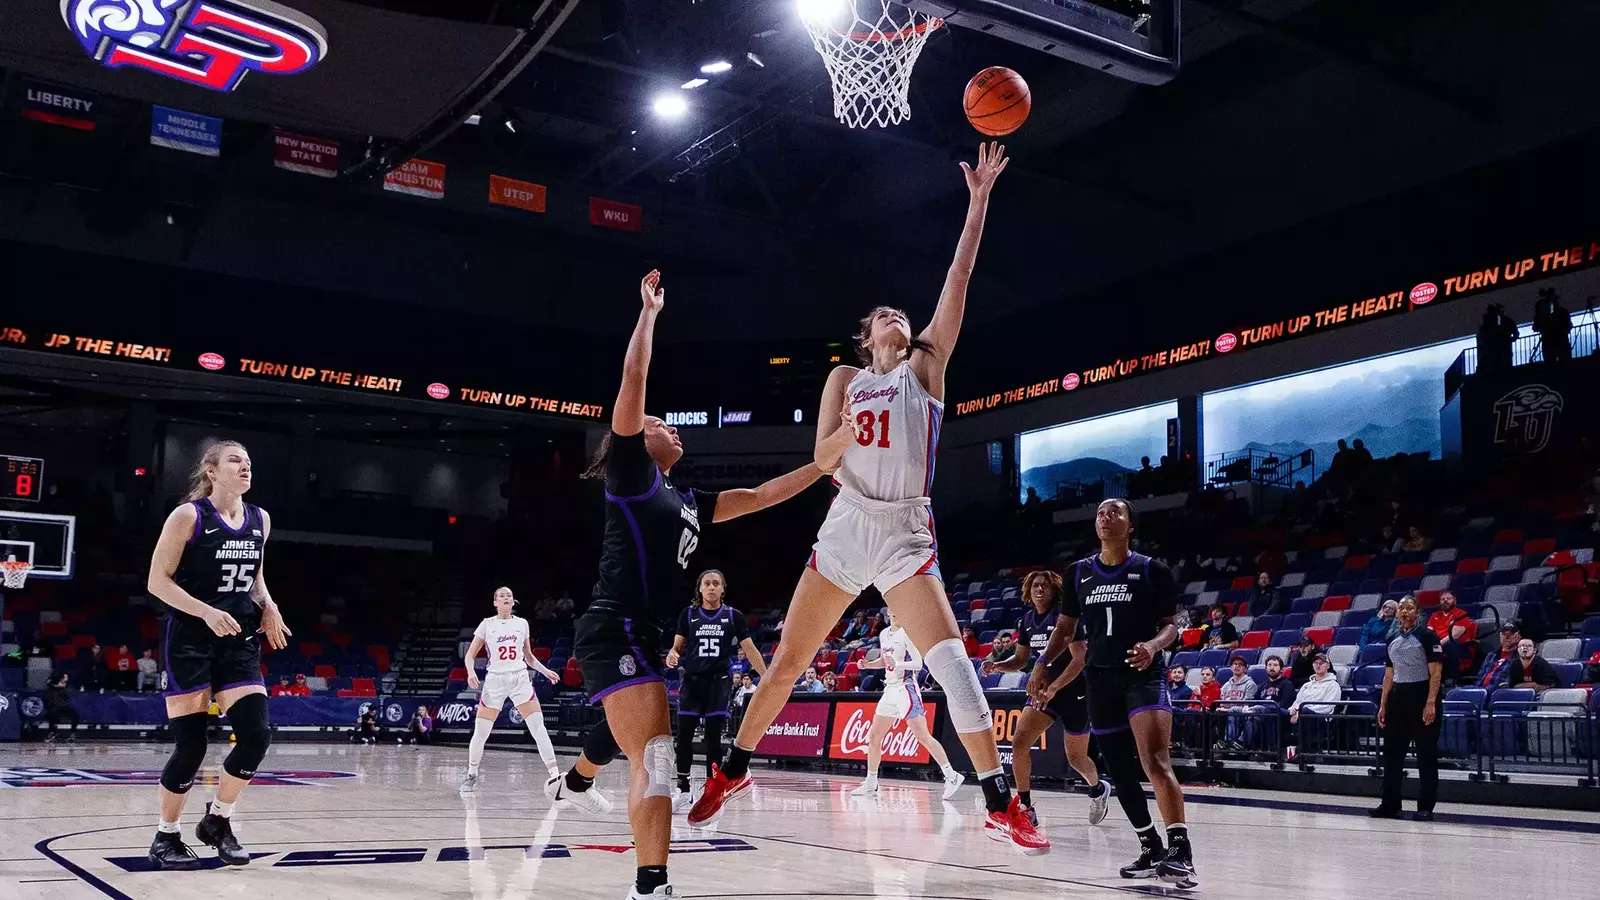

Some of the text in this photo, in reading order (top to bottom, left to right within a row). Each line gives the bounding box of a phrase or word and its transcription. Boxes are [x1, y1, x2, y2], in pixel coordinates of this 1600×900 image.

[27, 88, 93, 112] LIBERTY
[168, 114, 207, 131] MIDDLE
[157, 123, 217, 143] TENNESSEE
[275, 135, 338, 156] NEW MEXICO
[291, 150, 322, 163] STATE
[503, 187, 534, 201] UTEP
[603, 209, 629, 222] WKU
[1444, 266, 1500, 297] TURN
[1503, 258, 1535, 281] UP
[1540, 246, 1584, 273] THE
[1411, 287, 1435, 298] FOSTER
[1241, 291, 1404, 346] TURN UP THE HEAT!
[75, 336, 113, 355] THE
[117, 342, 171, 362] HEAT!
[1083, 340, 1210, 385] TURN UP THE HEAT!
[240, 358, 402, 392] TURN UP THE HEAT!
[460, 387, 603, 418] TURN UP THE HEAT!
[851, 385, 899, 405] Liberty
[956, 379, 1059, 416] TURN UP THE HEAT!
[666, 411, 708, 425] BLOCKS
[722, 411, 751, 423] JMU
[856, 410, 891, 448] 31
[16, 474, 32, 496] 8
[222, 540, 255, 550] JAMES
[215, 550, 260, 560] MADISON
[217, 564, 255, 593] 35
[1091, 584, 1128, 594] JAMES
[1085, 593, 1133, 605] MADISON
[1105, 606, 1113, 637] 1
[496, 634, 518, 643] Liberty
[698, 638, 720, 657] 25
[498, 646, 517, 660] 25
[783, 722, 800, 736] Bank
[804, 722, 820, 737] Trust
